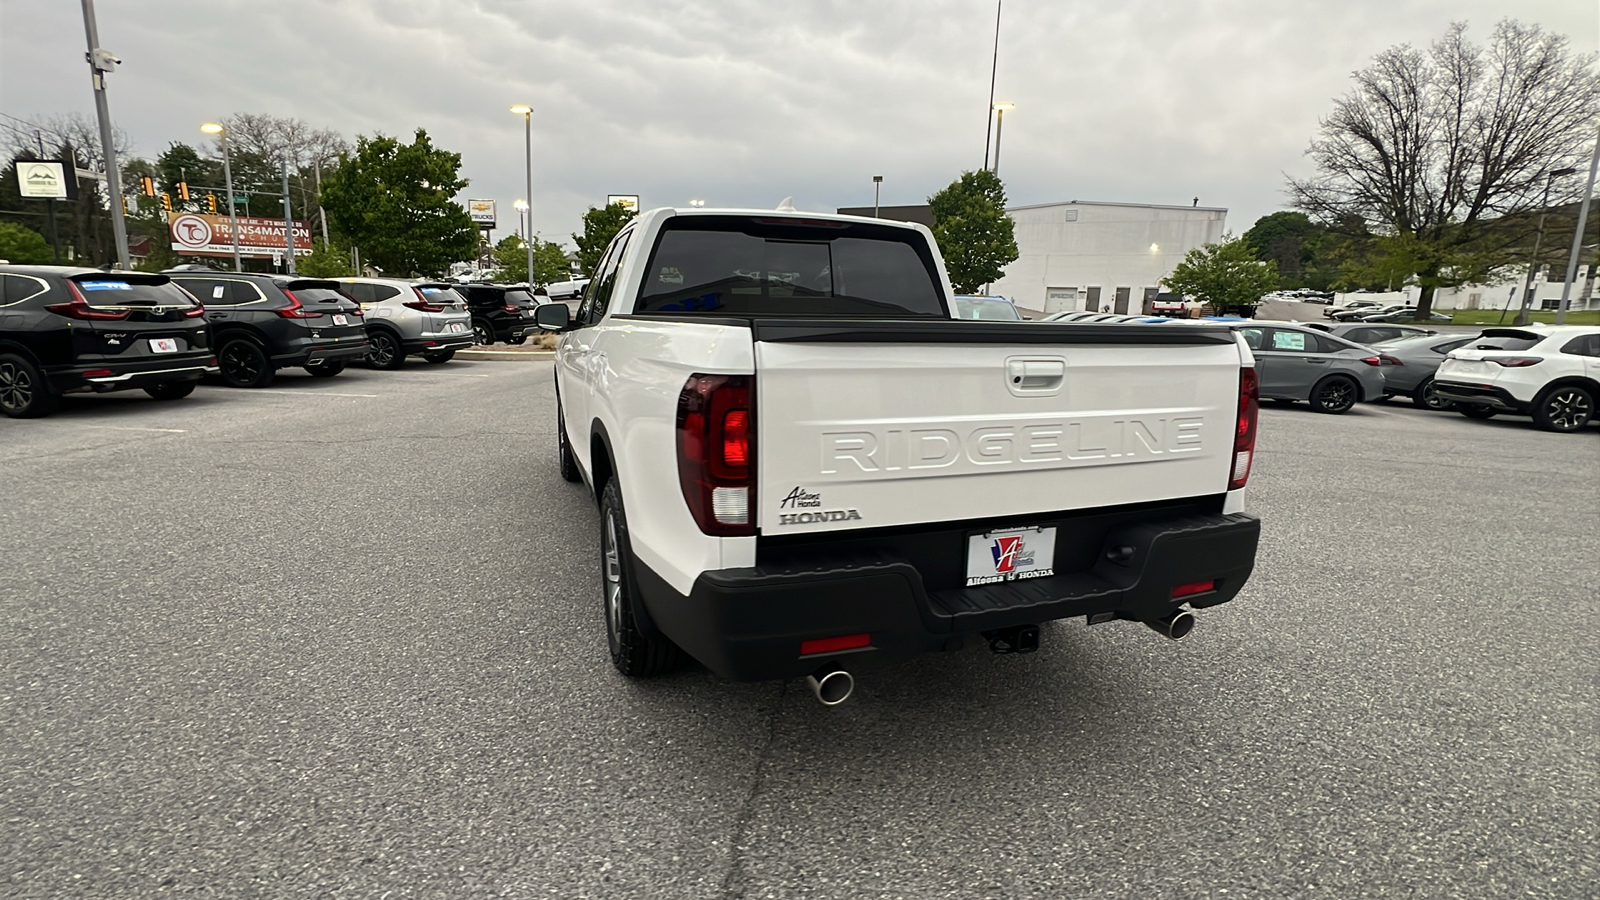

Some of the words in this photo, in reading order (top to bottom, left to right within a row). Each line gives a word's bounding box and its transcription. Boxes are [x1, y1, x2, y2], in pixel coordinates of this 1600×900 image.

[249, 234, 310, 243] CHURCH
[820, 416, 1204, 475] RIDGELINE
[779, 509, 863, 525] HONDA
[966, 575, 1004, 587] Altoona
[1018, 569, 1055, 580] HONDA
